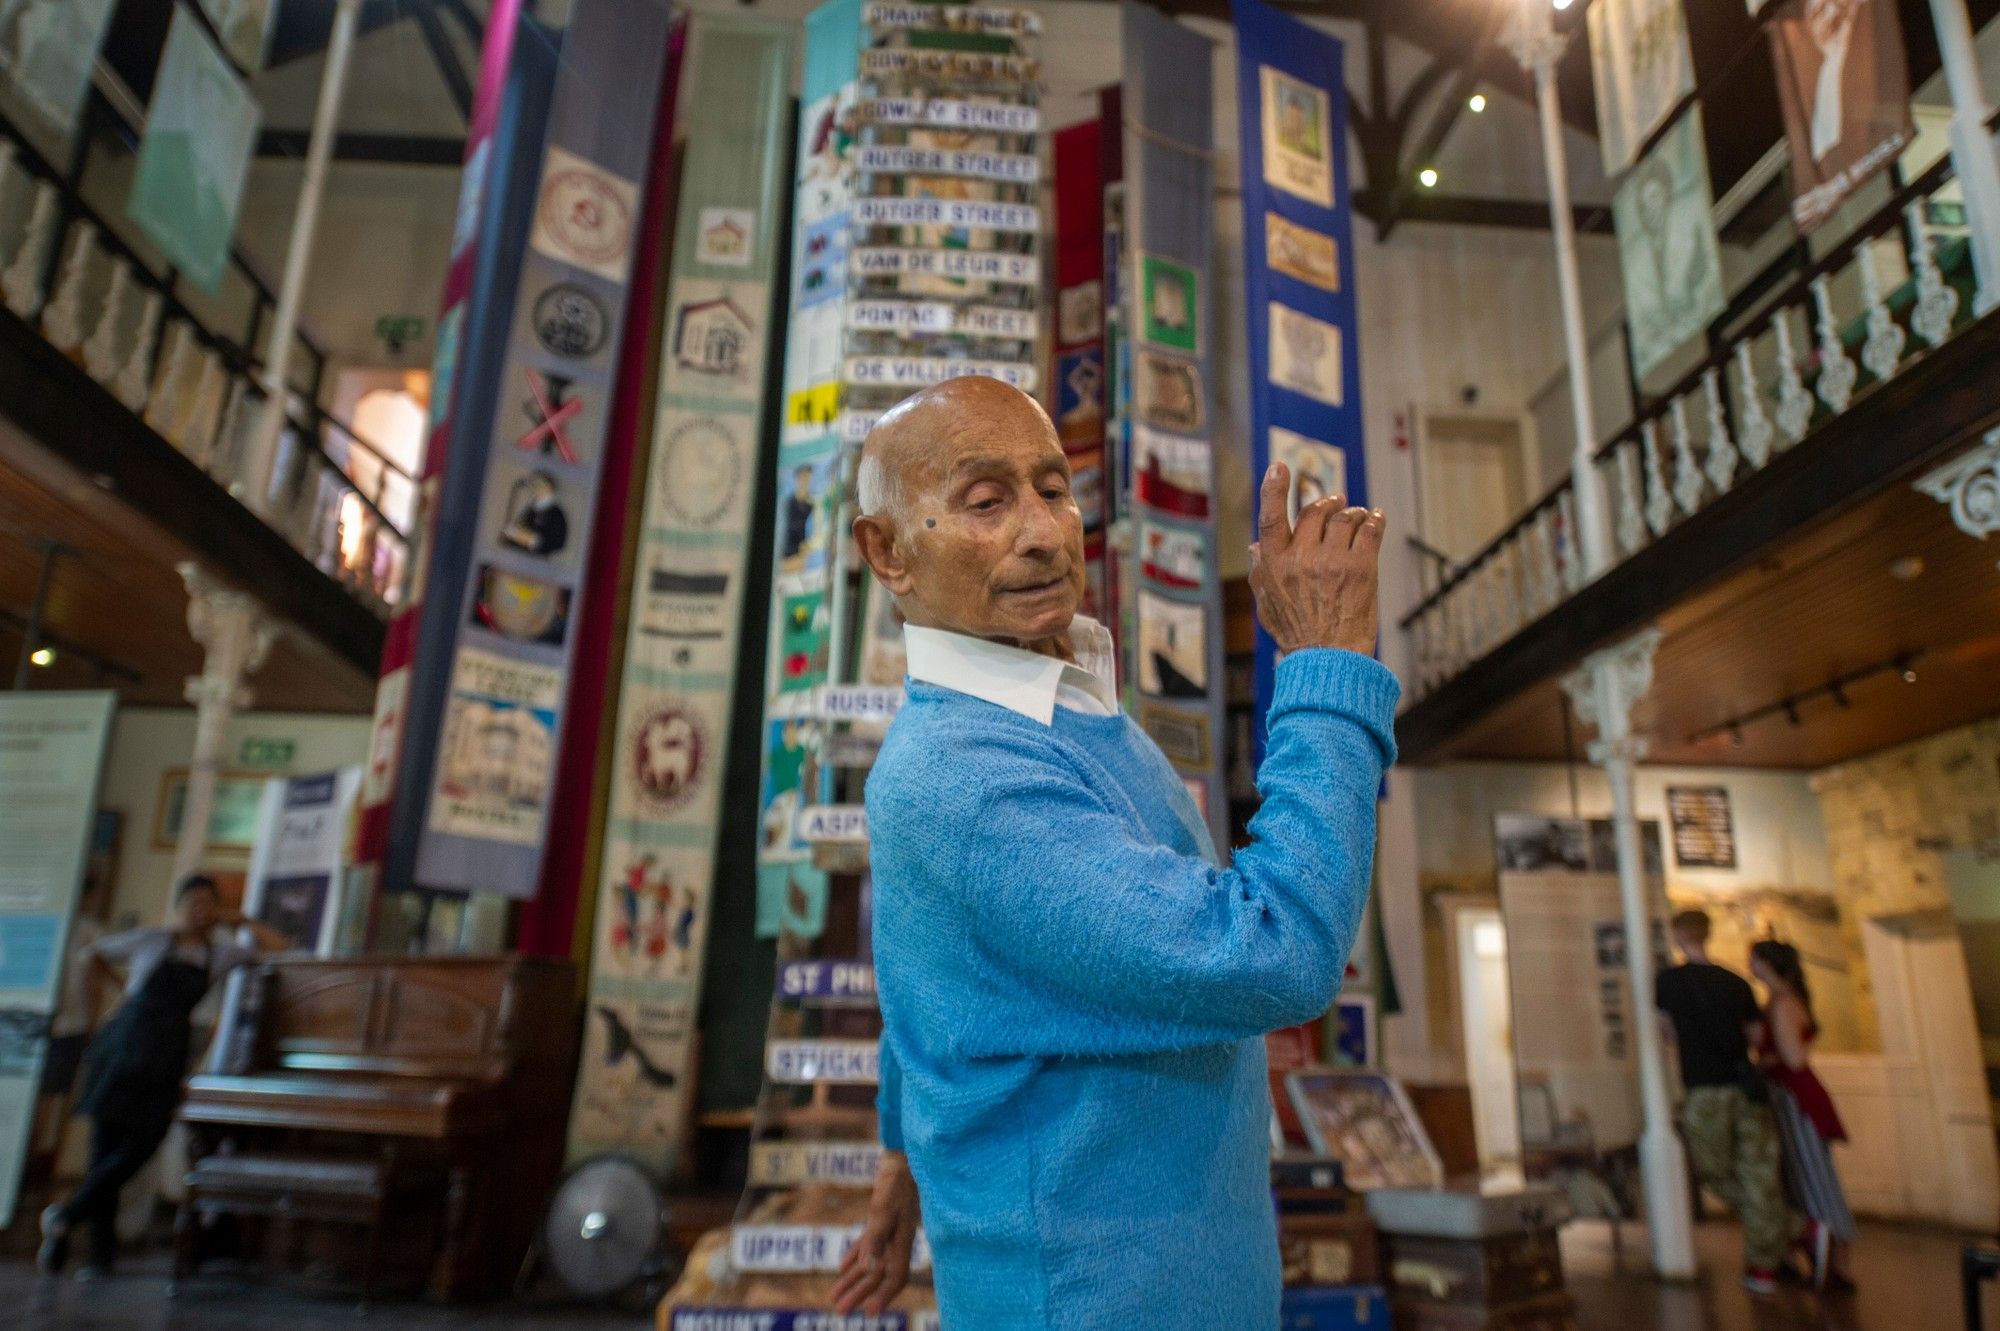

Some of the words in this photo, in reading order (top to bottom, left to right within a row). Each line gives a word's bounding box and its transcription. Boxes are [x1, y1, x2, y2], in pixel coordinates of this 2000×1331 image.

[955, 104, 1031, 127] STREET
[862, 149, 942, 170] RUTGER
[951, 151, 1031, 177] STREET
[860, 200, 942, 221] RUTGER
[951, 203, 1031, 228] STREET
[859, 252, 900, 269] VAN
[907, 253, 934, 271] DE
[853, 362, 883, 378] DE
[784, 963, 822, 994] ST
[743, 1234, 826, 1262] UPPER
